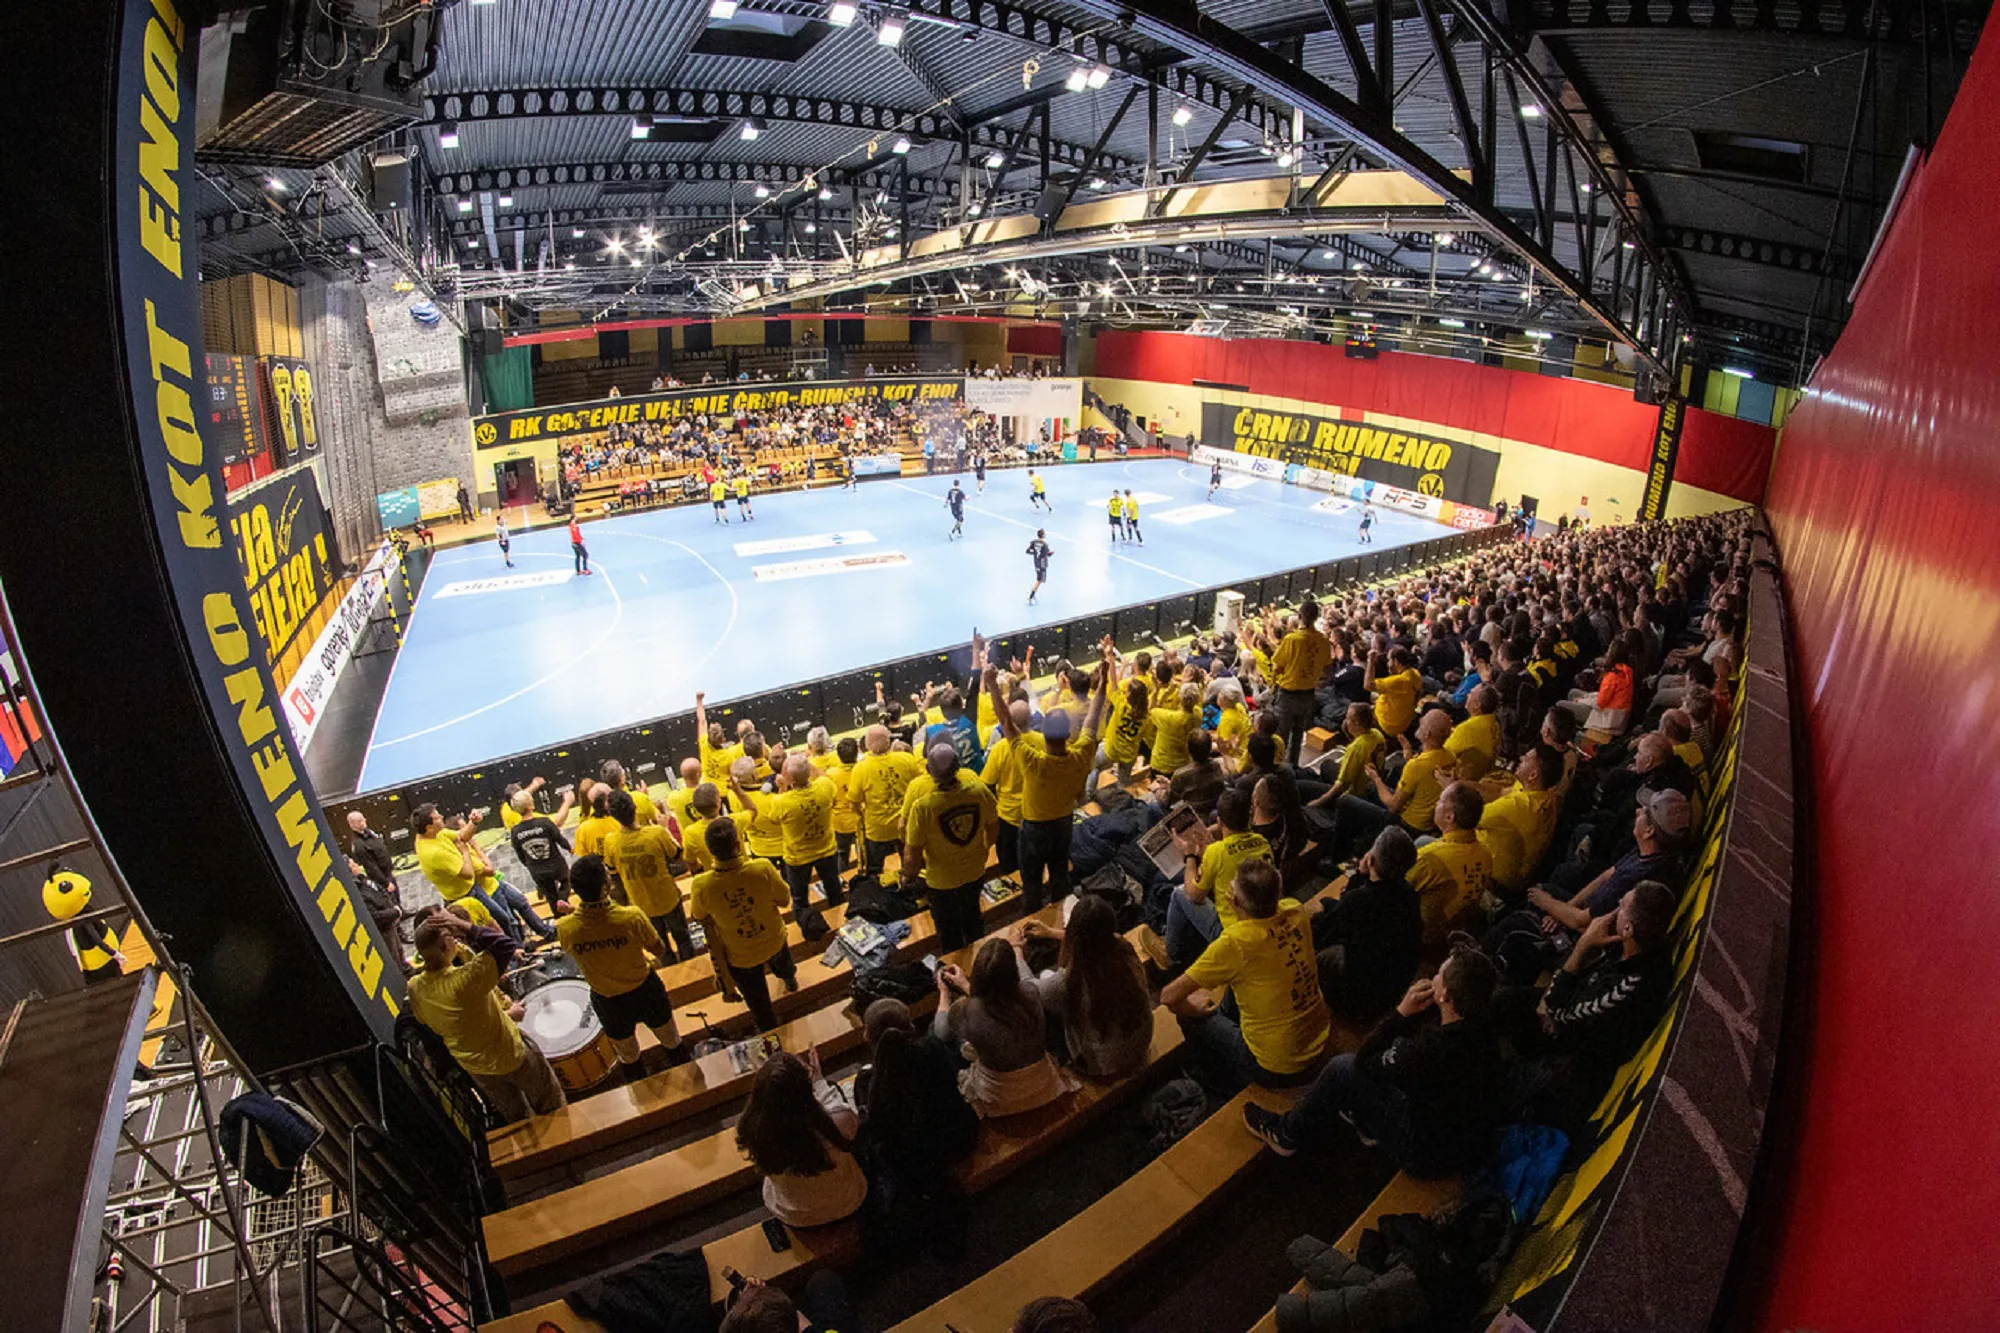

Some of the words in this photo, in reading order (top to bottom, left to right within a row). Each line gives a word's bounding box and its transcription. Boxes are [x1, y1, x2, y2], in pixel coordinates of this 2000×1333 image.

[145, 299, 222, 548] KOT
[509, 416, 542, 439] RK
[882, 384, 916, 400] KOT
[920, 383, 958, 400] ENO!
[1233, 407, 1310, 442] ČRNO
[1313, 421, 1452, 471] RUMENO
[1657, 431, 1673, 461] KOT
[320, 623, 351, 676] gorenje
[573, 935, 628, 955] gorenje
